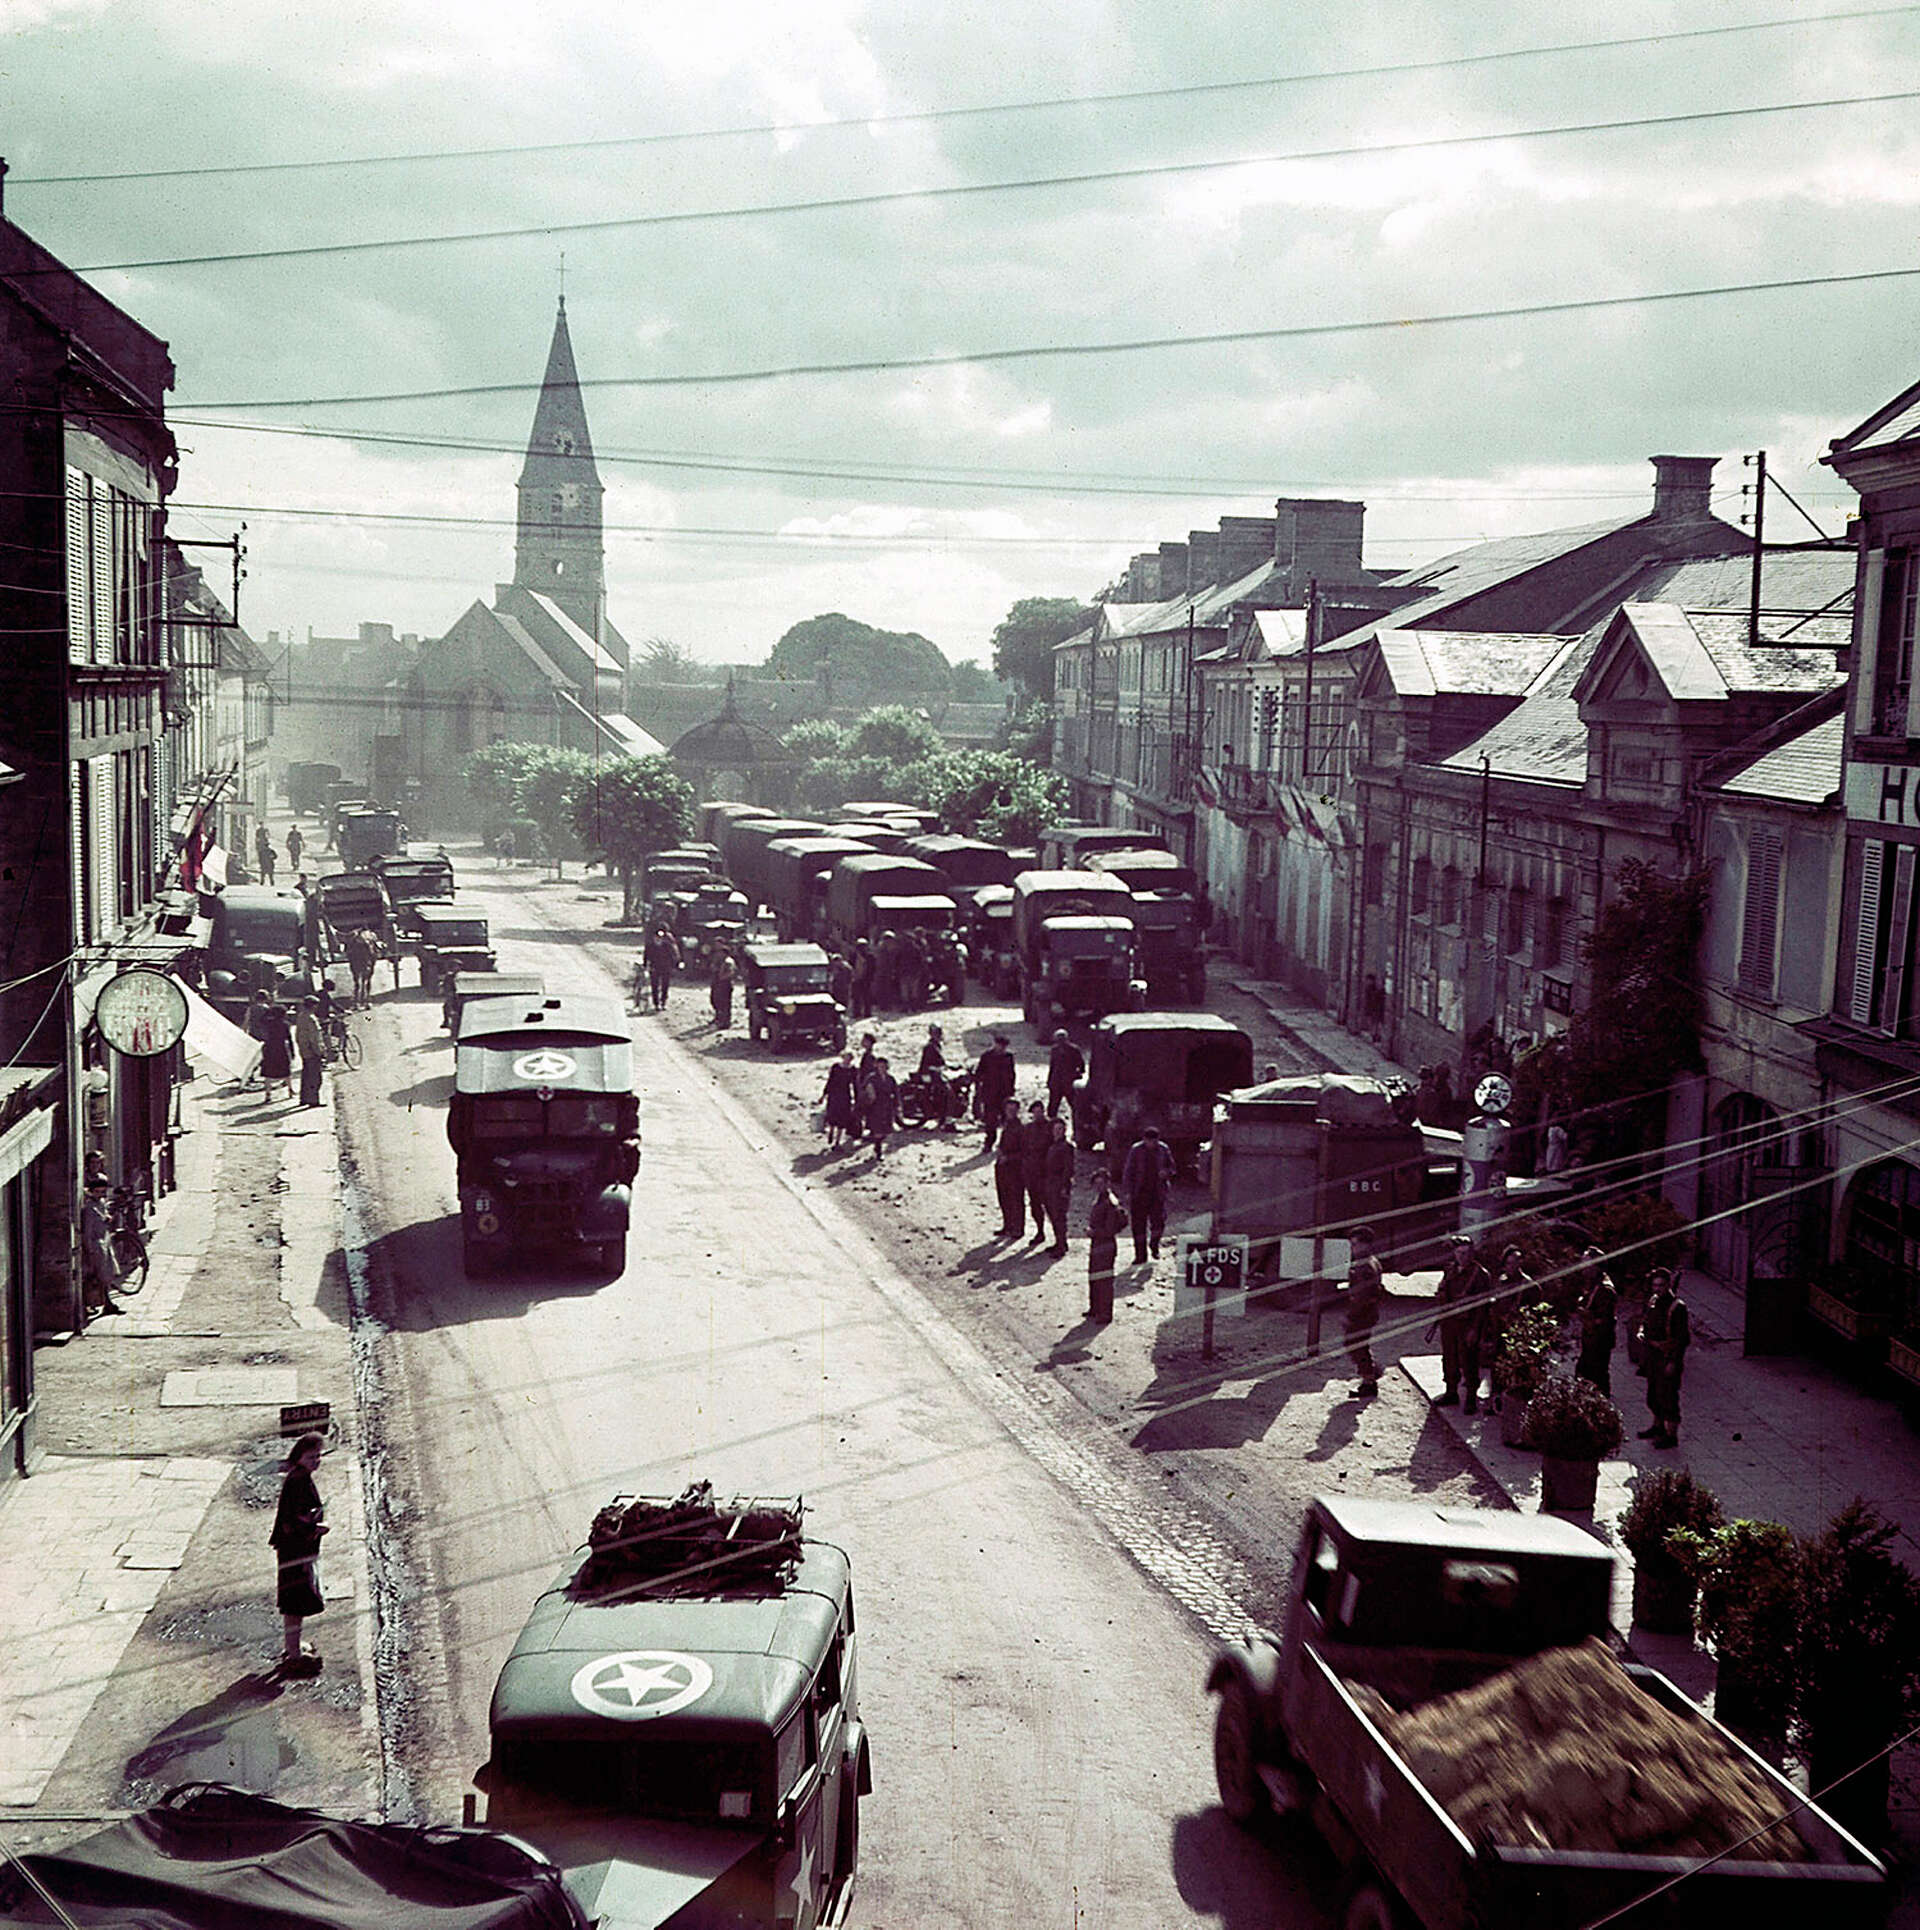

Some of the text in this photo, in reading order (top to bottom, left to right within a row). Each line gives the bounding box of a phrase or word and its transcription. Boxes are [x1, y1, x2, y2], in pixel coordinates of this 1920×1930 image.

[1879, 767, 1920, 825] H
[1350, 1181, 1381, 1192] BBC
[1207, 1248, 1240, 1265] FDS
[283, 1405, 328, 1420] ENTRY
